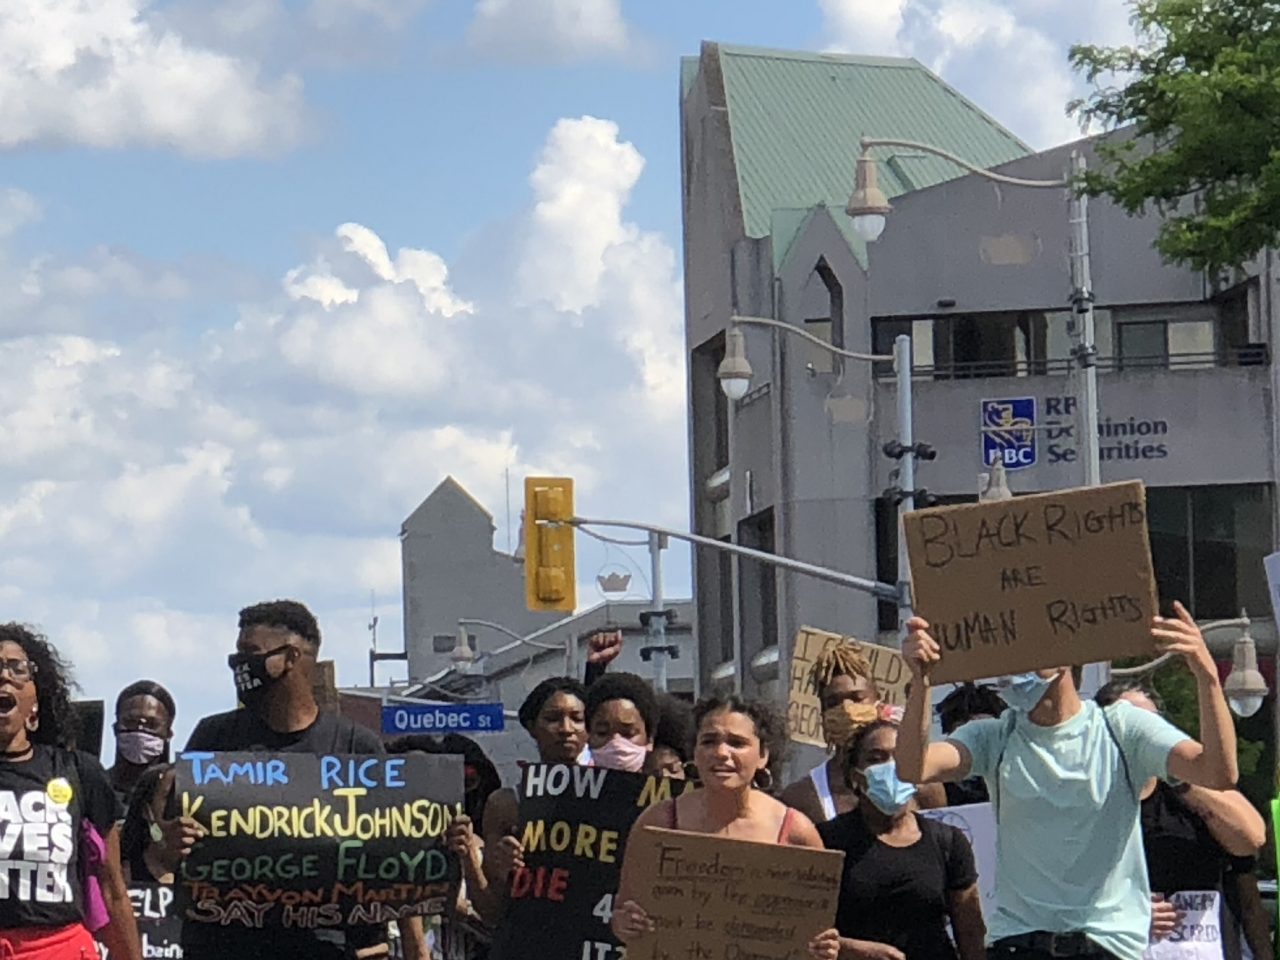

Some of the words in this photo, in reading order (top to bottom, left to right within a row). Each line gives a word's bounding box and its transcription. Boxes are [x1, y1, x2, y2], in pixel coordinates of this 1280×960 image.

[1046, 417, 1167, 439] Doinion
[921, 511, 1037, 568] BLACK
[1044, 502, 1144, 545] RIGHTS
[1001, 566, 1046, 591] ARE
[1047, 595, 1144, 635] RIGHTS
[395, 710, 470, 729] Quebec
[478, 714, 491, 727] St
[180, 752, 288, 785] TAMIR
[321, 756, 406, 790] RICE
[526, 764, 608, 799] HOW
[182, 791, 334, 838] KENDRICK
[333, 787, 462, 840] JOHNSON
[521, 819, 619, 863] MORE
[181, 846, 320, 882] GEORGE
[338, 840, 448, 881] FLOYD
[182, 881, 328, 905] TRAYVON
[510, 866, 569, 902] DIE
[127, 886, 173, 918] ELP
[185, 899, 275, 928] SAY
[282, 903, 342, 928] HIS
[347, 896, 448, 925] NAME
